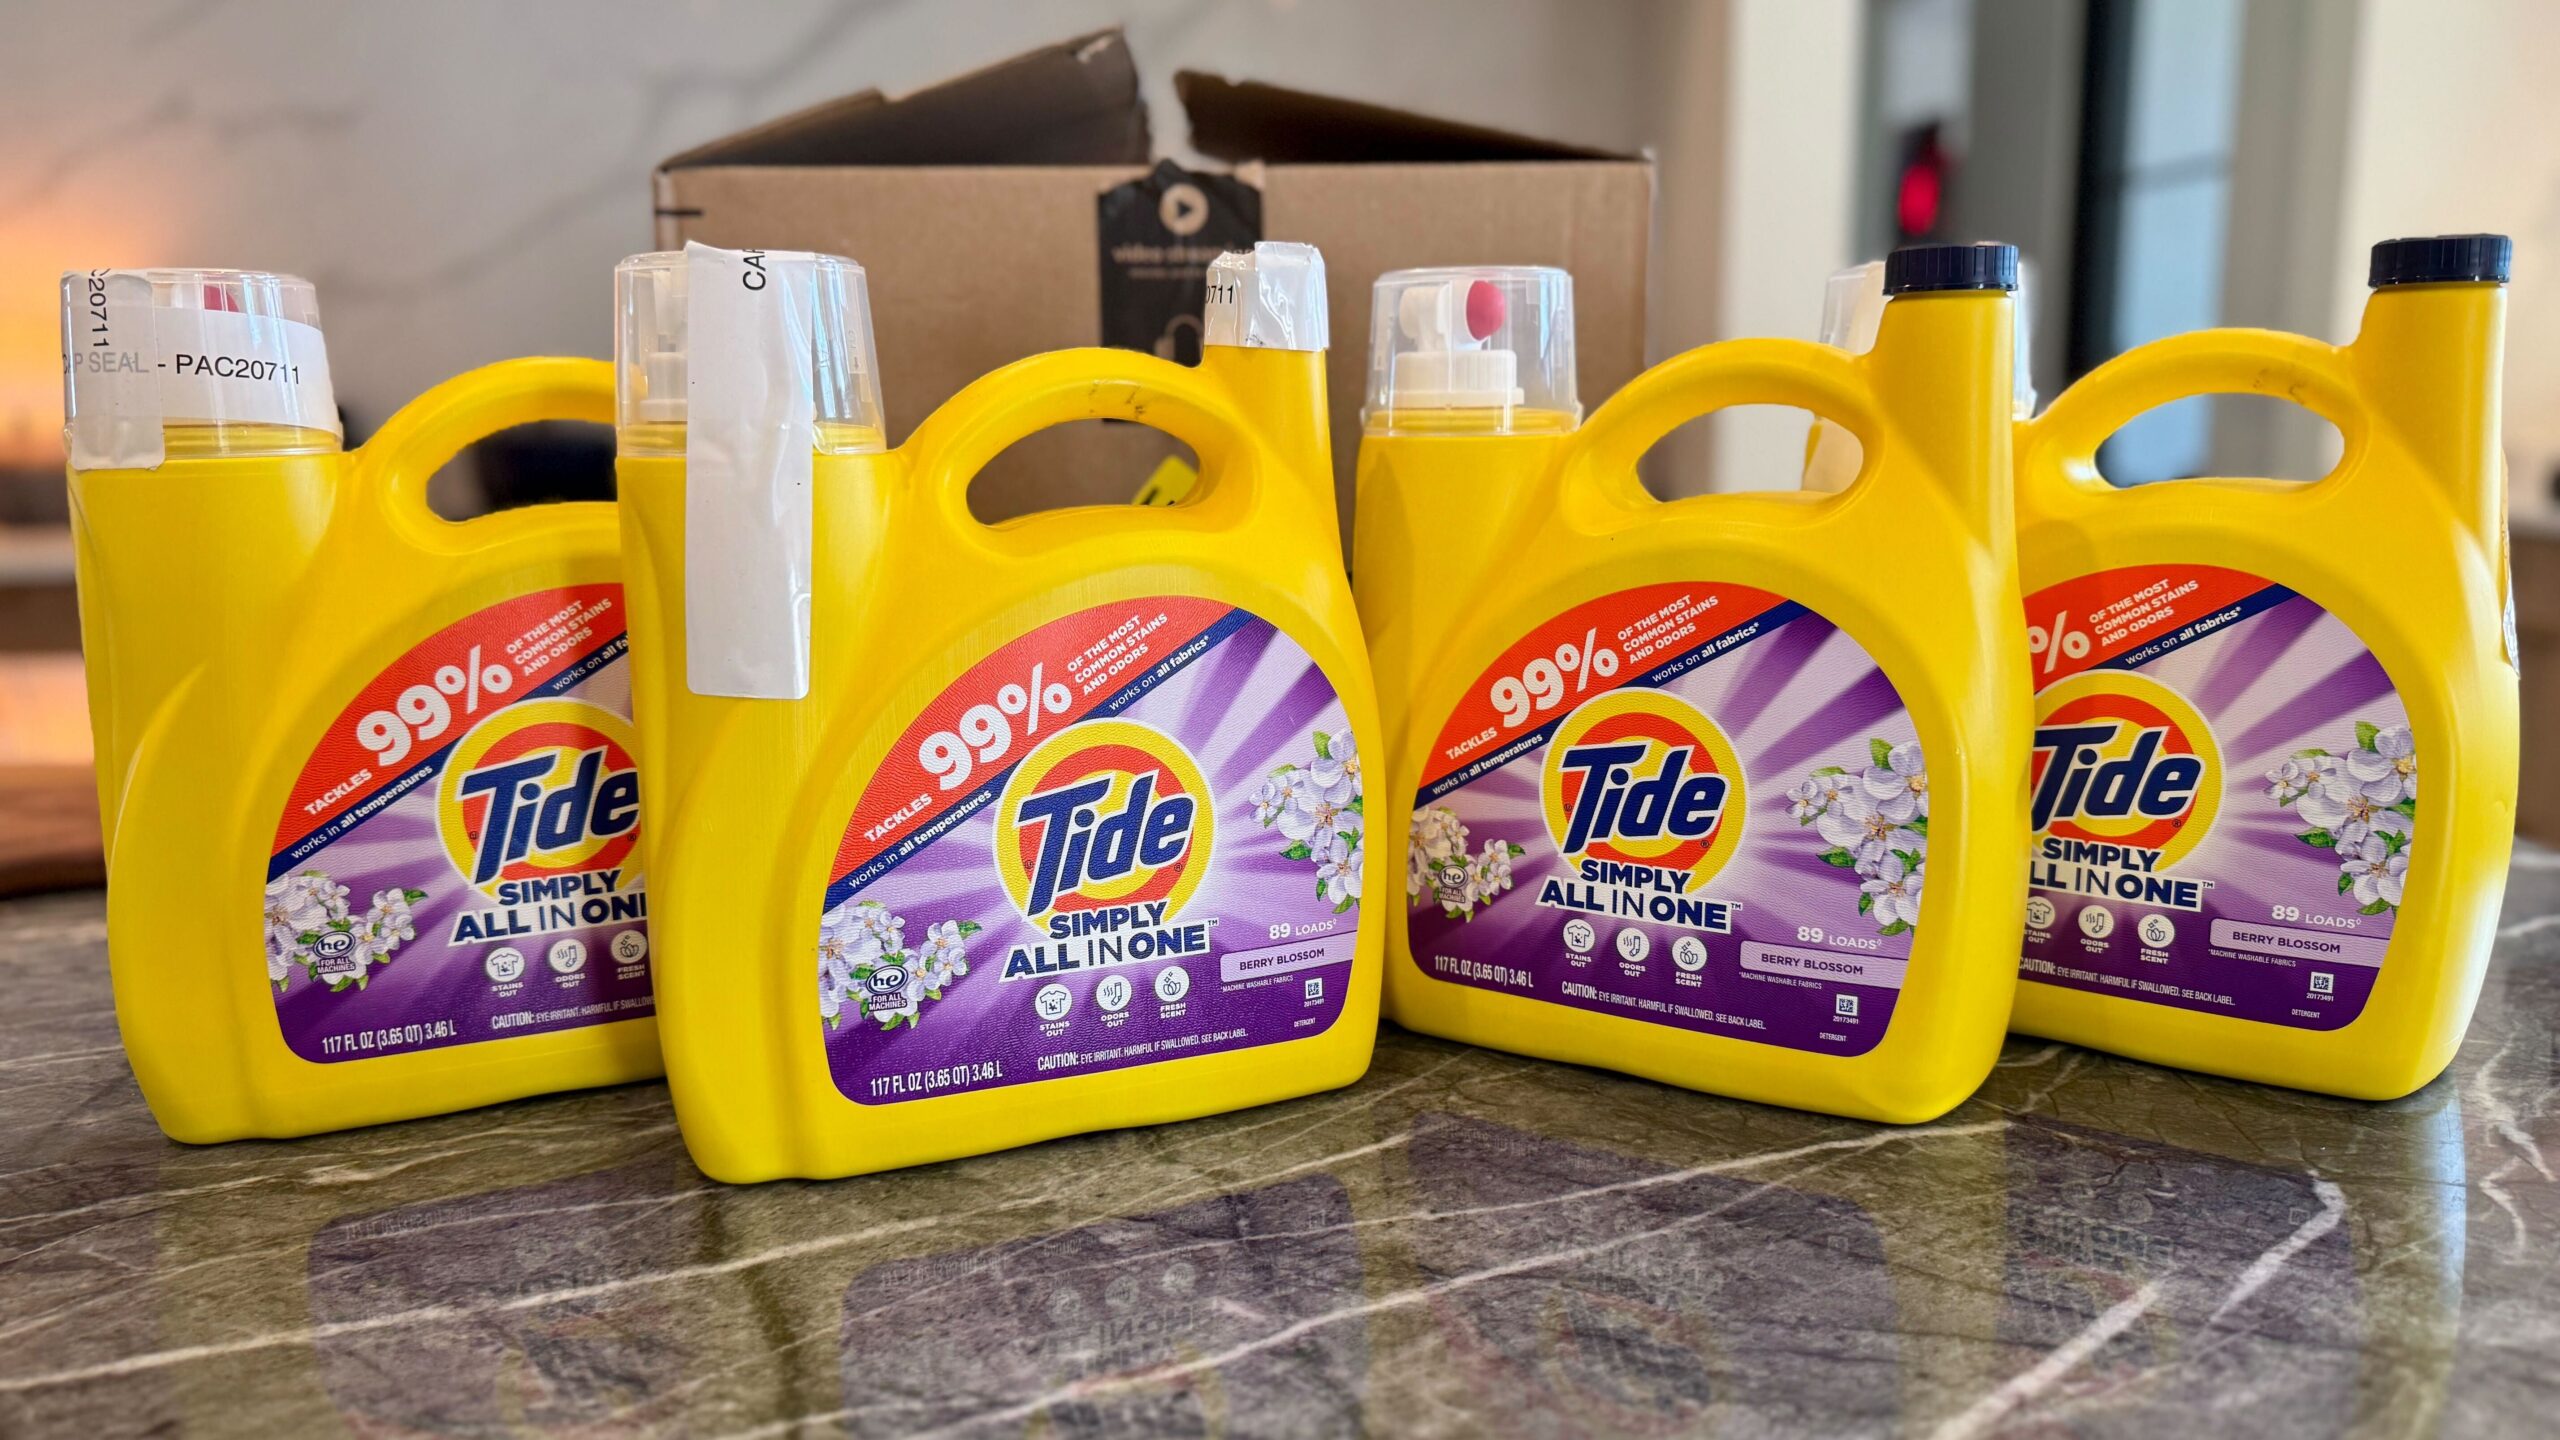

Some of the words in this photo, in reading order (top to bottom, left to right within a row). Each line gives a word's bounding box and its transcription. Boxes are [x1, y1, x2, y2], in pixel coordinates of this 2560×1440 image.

[88, 352, 148, 374] SEAL
[175, 354, 299, 385] PAC20711
[1617, 626, 1633, 641] OF
[1634, 614, 1659, 633] THE
[1658, 594, 1692, 621] MOST
[2089, 608, 2107, 623] OF
[2107, 595, 2134, 618] THE
[2133, 578, 2170, 604] MOST
[2094, 603, 2151, 635] COMMON
[2151, 580, 2199, 608] STAINS
[506, 636, 524, 655] OF
[524, 624, 549, 644] THE
[548, 600, 583, 627] MOST
[514, 628, 570, 665] COMMON
[567, 598, 612, 633] STAINS
[1067, 654, 1084, 673] OF
[1084, 639, 1109, 662] THE
[1108, 614, 1142, 645] MOST
[1622, 619, 1675, 652] COMMON
[1674, 596, 1720, 625] STAINS
[1629, 644, 1654, 665] AND
[1654, 622, 1697, 651] ODORS
[2101, 628, 2128, 647] AND
[2130, 606, 2174, 634] ODORS
[2125, 643, 2160, 665] works
[2162, 635, 2178, 648] on
[2179, 626, 2194, 642] all
[523, 654, 550, 677] AND
[550, 627, 593, 658] ODORS
[553, 667, 587, 691] works
[587, 655, 601, 669] on
[601, 642, 618, 660] all
[1074, 644, 1127, 684] COMMON
[1125, 612, 1168, 648] STAINS
[1083, 672, 1110, 696] AND
[1109, 643, 1149, 677] ODORS
[1652, 661, 1685, 683] works
[1685, 652, 1701, 666] on
[1701, 640, 1715, 658] all
[1109, 686, 1141, 711] works
[1141, 674, 1156, 688] on
[1155, 661, 1170, 678] all
[1445, 727, 1498, 760] TACKLES
[1490, 627, 1619, 728] 99%
[304, 767, 372, 816] TACKLES
[356, 644, 513, 767] 99%
[863, 793, 933, 843] TACKLES
[918, 662, 1072, 791] 99%
[1432, 774, 1459, 796] works
[1458, 769, 1469, 782] in
[1469, 761, 1482, 776] all
[1481, 733, 1544, 772] temperatures
[1561, 744, 1726, 854] Tide
[2032, 725, 2202, 832] Tide
[291, 832, 328, 859] works
[327, 824, 341, 839] in
[340, 812, 357, 830] all
[356, 765, 433, 820] temperatures
[459, 745, 640, 884] Tide
[848, 862, 885, 889] works
[884, 851, 898, 866] in
[898, 839, 913, 857] all
[914, 789, 992, 847] temperatures
[1017, 774, 1194, 916] Tide
[2041, 837, 2161, 873] SIMPLY
[498, 869, 621, 906] SIMPLY
[1580, 859, 1692, 894] SIMPLY
[2029, 861, 2067, 889] LL
[2075, 867, 2110, 896] IN
[1540, 880, 1604, 912] ALL
[1612, 888, 1644, 918] IN
[2271, 905, 2300, 921] 89
[453, 911, 532, 944] ALL
[539, 901, 576, 931] IN
[1049, 902, 1167, 940] SIMPLY
[1269, 922, 1291, 940] 89
[1797, 926, 1823, 943] 89
[1004, 942, 1080, 978] ALL
[1088, 935, 1123, 966] IN
[1239, 955, 1274, 971] BERRY
[1277, 948, 1325, 966] BLOSSOM
[1761, 953, 1800, 967] BERRY
[1803, 958, 1863, 975] BLOSSOM
[2232, 932, 2274, 945] BERRY
[2278, 938, 2341, 954] BLOSSOM
[872, 994, 888, 1003] FOR
[888, 992, 902, 1001] ALL
[1246, 976, 1272, 990] WASHABLE
[1273, 974, 1294, 986] FABRICS
[868, 1000, 906, 1011] MACHINES
[1040, 1021, 1070, 1031] STAINS
[1101, 1011, 1129, 1021] ODORS
[1106, 1018, 1124, 1028] OUT
[1160, 1002, 1186, 1011] FRESH
[1160, 1009, 1187, 1019] SCENT
[1293, 1017, 1316, 1028] DETERGENT
[1561, 981, 1598, 1000] CAUTION:
[1598, 990, 1610, 1002] EYE
[1611, 992, 1638, 1008] IRRITANT.
[1638, 998, 1667, 1014] HARMFUL
[1668, 1002, 1674, 1014] IF
[1674, 1003, 1714, 1022] SWALLOWED.
[1715, 1012, 1727, 1024] SEE
[1728, 1014, 1746, 1027] BACK
[1746, 1017, 1767, 1031] LABEL.
[322, 1035, 343, 1054] 117
[344, 1033, 358, 1051] FL
[360, 1030, 376, 1050] OZ
[377, 1026, 404, 1051] (3.65
[405, 1025, 423, 1044] QT)
[425, 1021, 447, 1039] 3.46
[448, 1019, 457, 1036] L
[1038, 1052, 1079, 1070] CAUTION:
[1080, 1052, 1093, 1065] EYE
[1094, 1047, 1123, 1063] IRRITANT.
[1124, 1042, 1153, 1058] HARMFUL
[1154, 1039, 1160, 1052] IF
[1160, 1034, 1200, 1051] SWALLOWED.
[1201, 1032, 1213, 1044] SEE
[1213, 1030, 1228, 1043] BACK
[1229, 1027, 1249, 1040] LABEL.
[1046, 1028, 1064, 1037] OUT
[870, 1076, 891, 1096] 117
[892, 1074, 906, 1093] FL
[908, 1072, 922, 1092] OZ
[925, 1068, 949, 1092] (3.65
[952, 1064, 970, 1086] QT)
[972, 1063, 994, 1082] 3.46
[994, 1061, 1003, 1078] L
